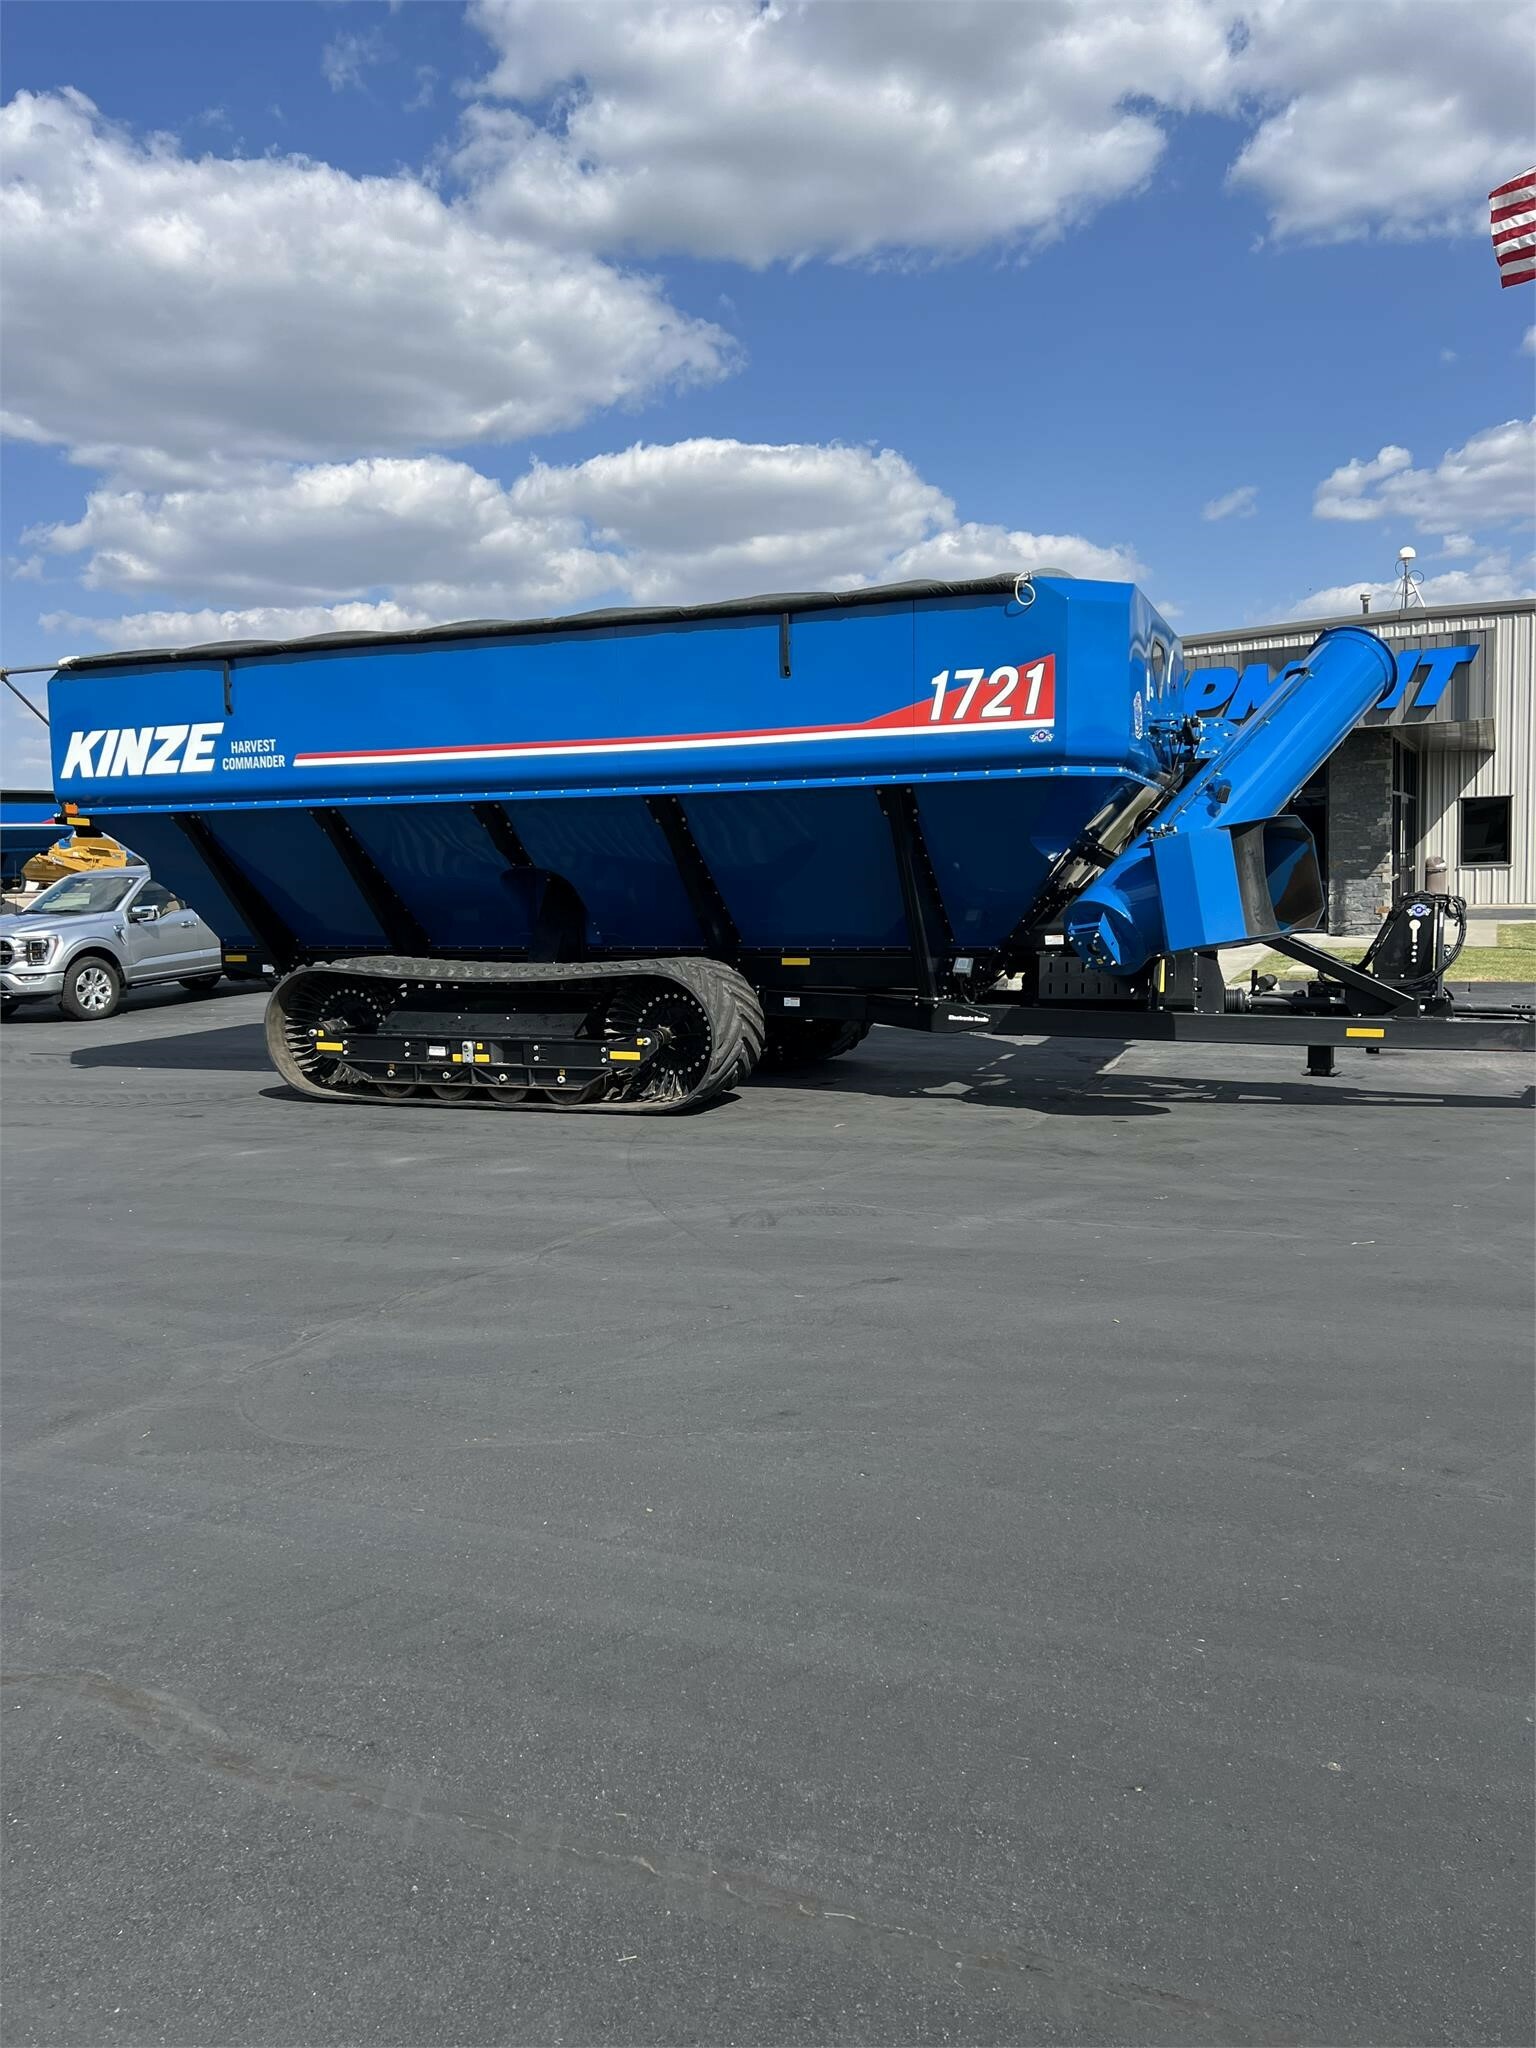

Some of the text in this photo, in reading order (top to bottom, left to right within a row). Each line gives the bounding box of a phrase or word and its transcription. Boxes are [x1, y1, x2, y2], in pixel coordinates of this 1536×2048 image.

[930, 662, 1046, 721] 1721
[60, 722, 225, 779] KINZE
[222, 755, 285, 770] COMMANDER
[231, 739, 276, 754] HARVEST
